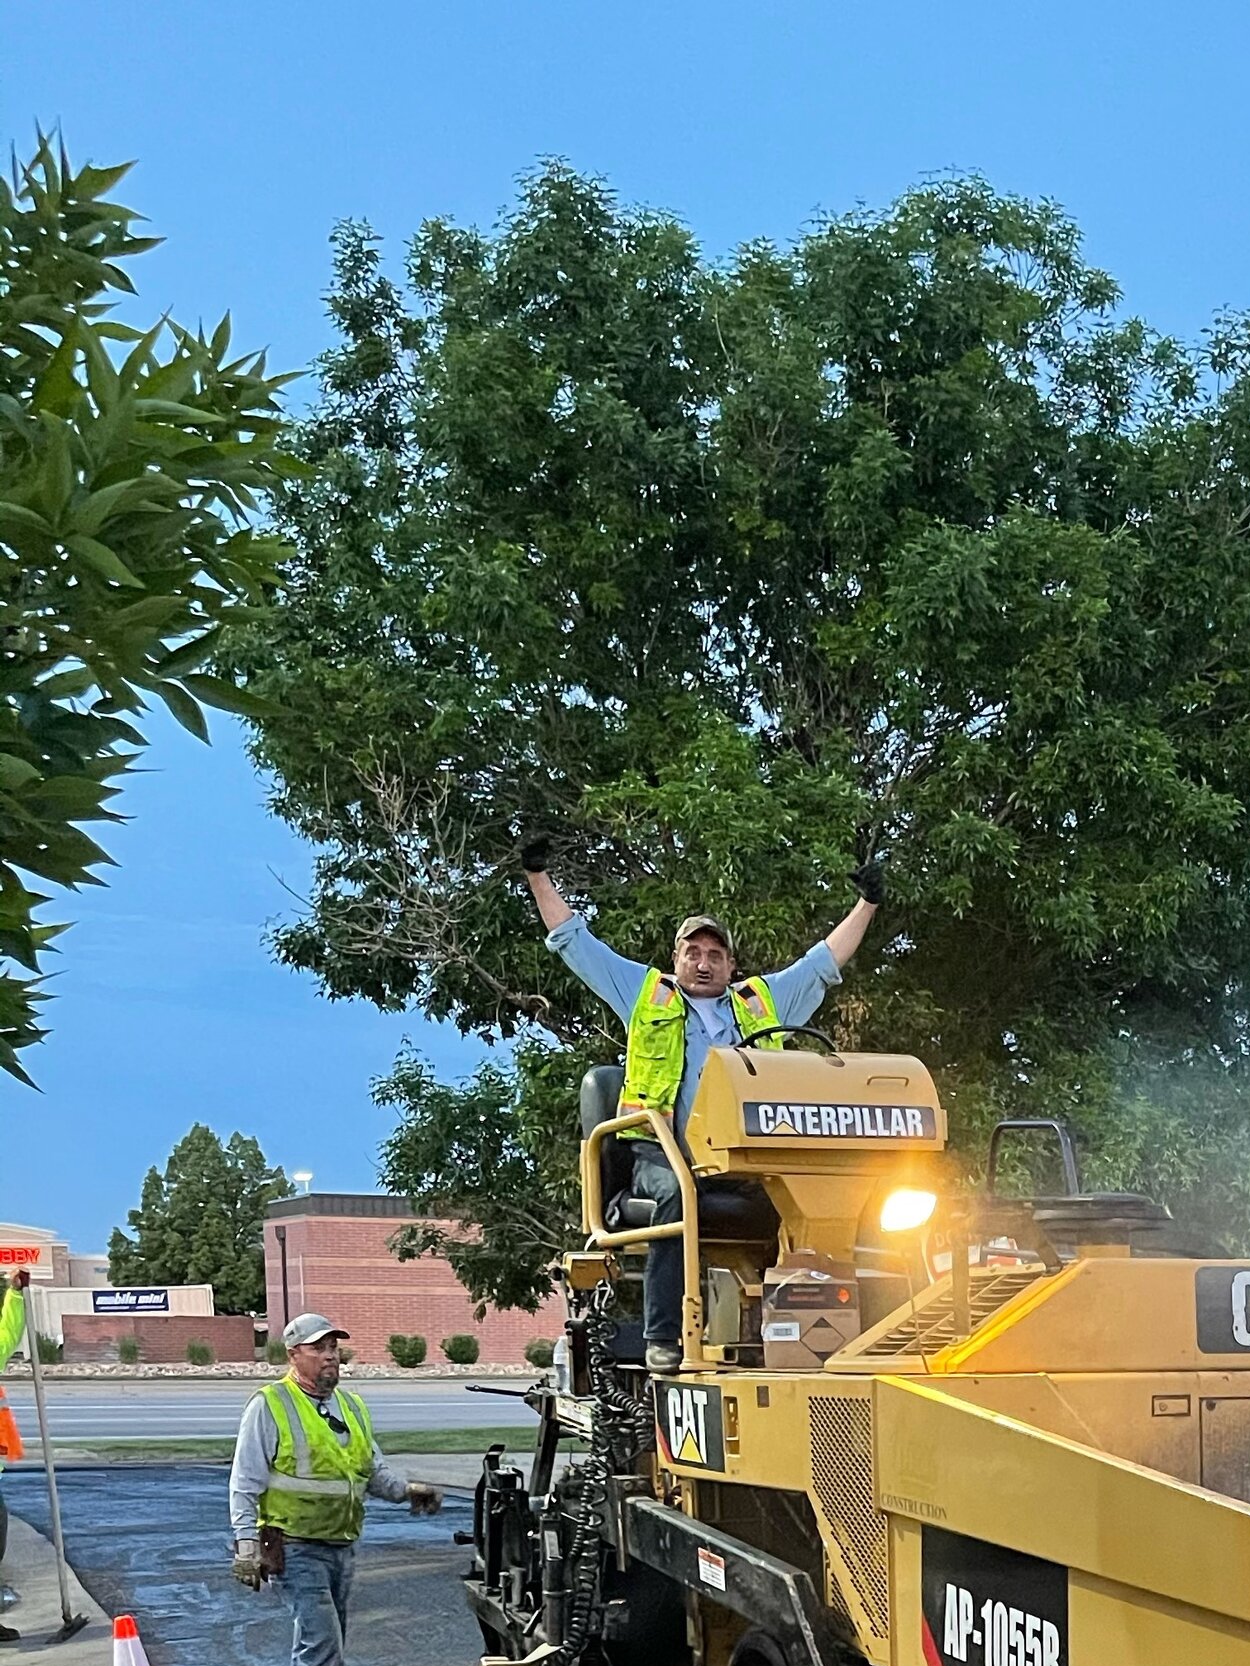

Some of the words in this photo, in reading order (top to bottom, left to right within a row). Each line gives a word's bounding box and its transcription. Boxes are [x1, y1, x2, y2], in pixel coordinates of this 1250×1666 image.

[758, 1104, 924, 1137] CATERPILLAR
[668, 1387, 708, 1464] CAT
[881, 1493, 948, 1520] CONSTRUCTION
